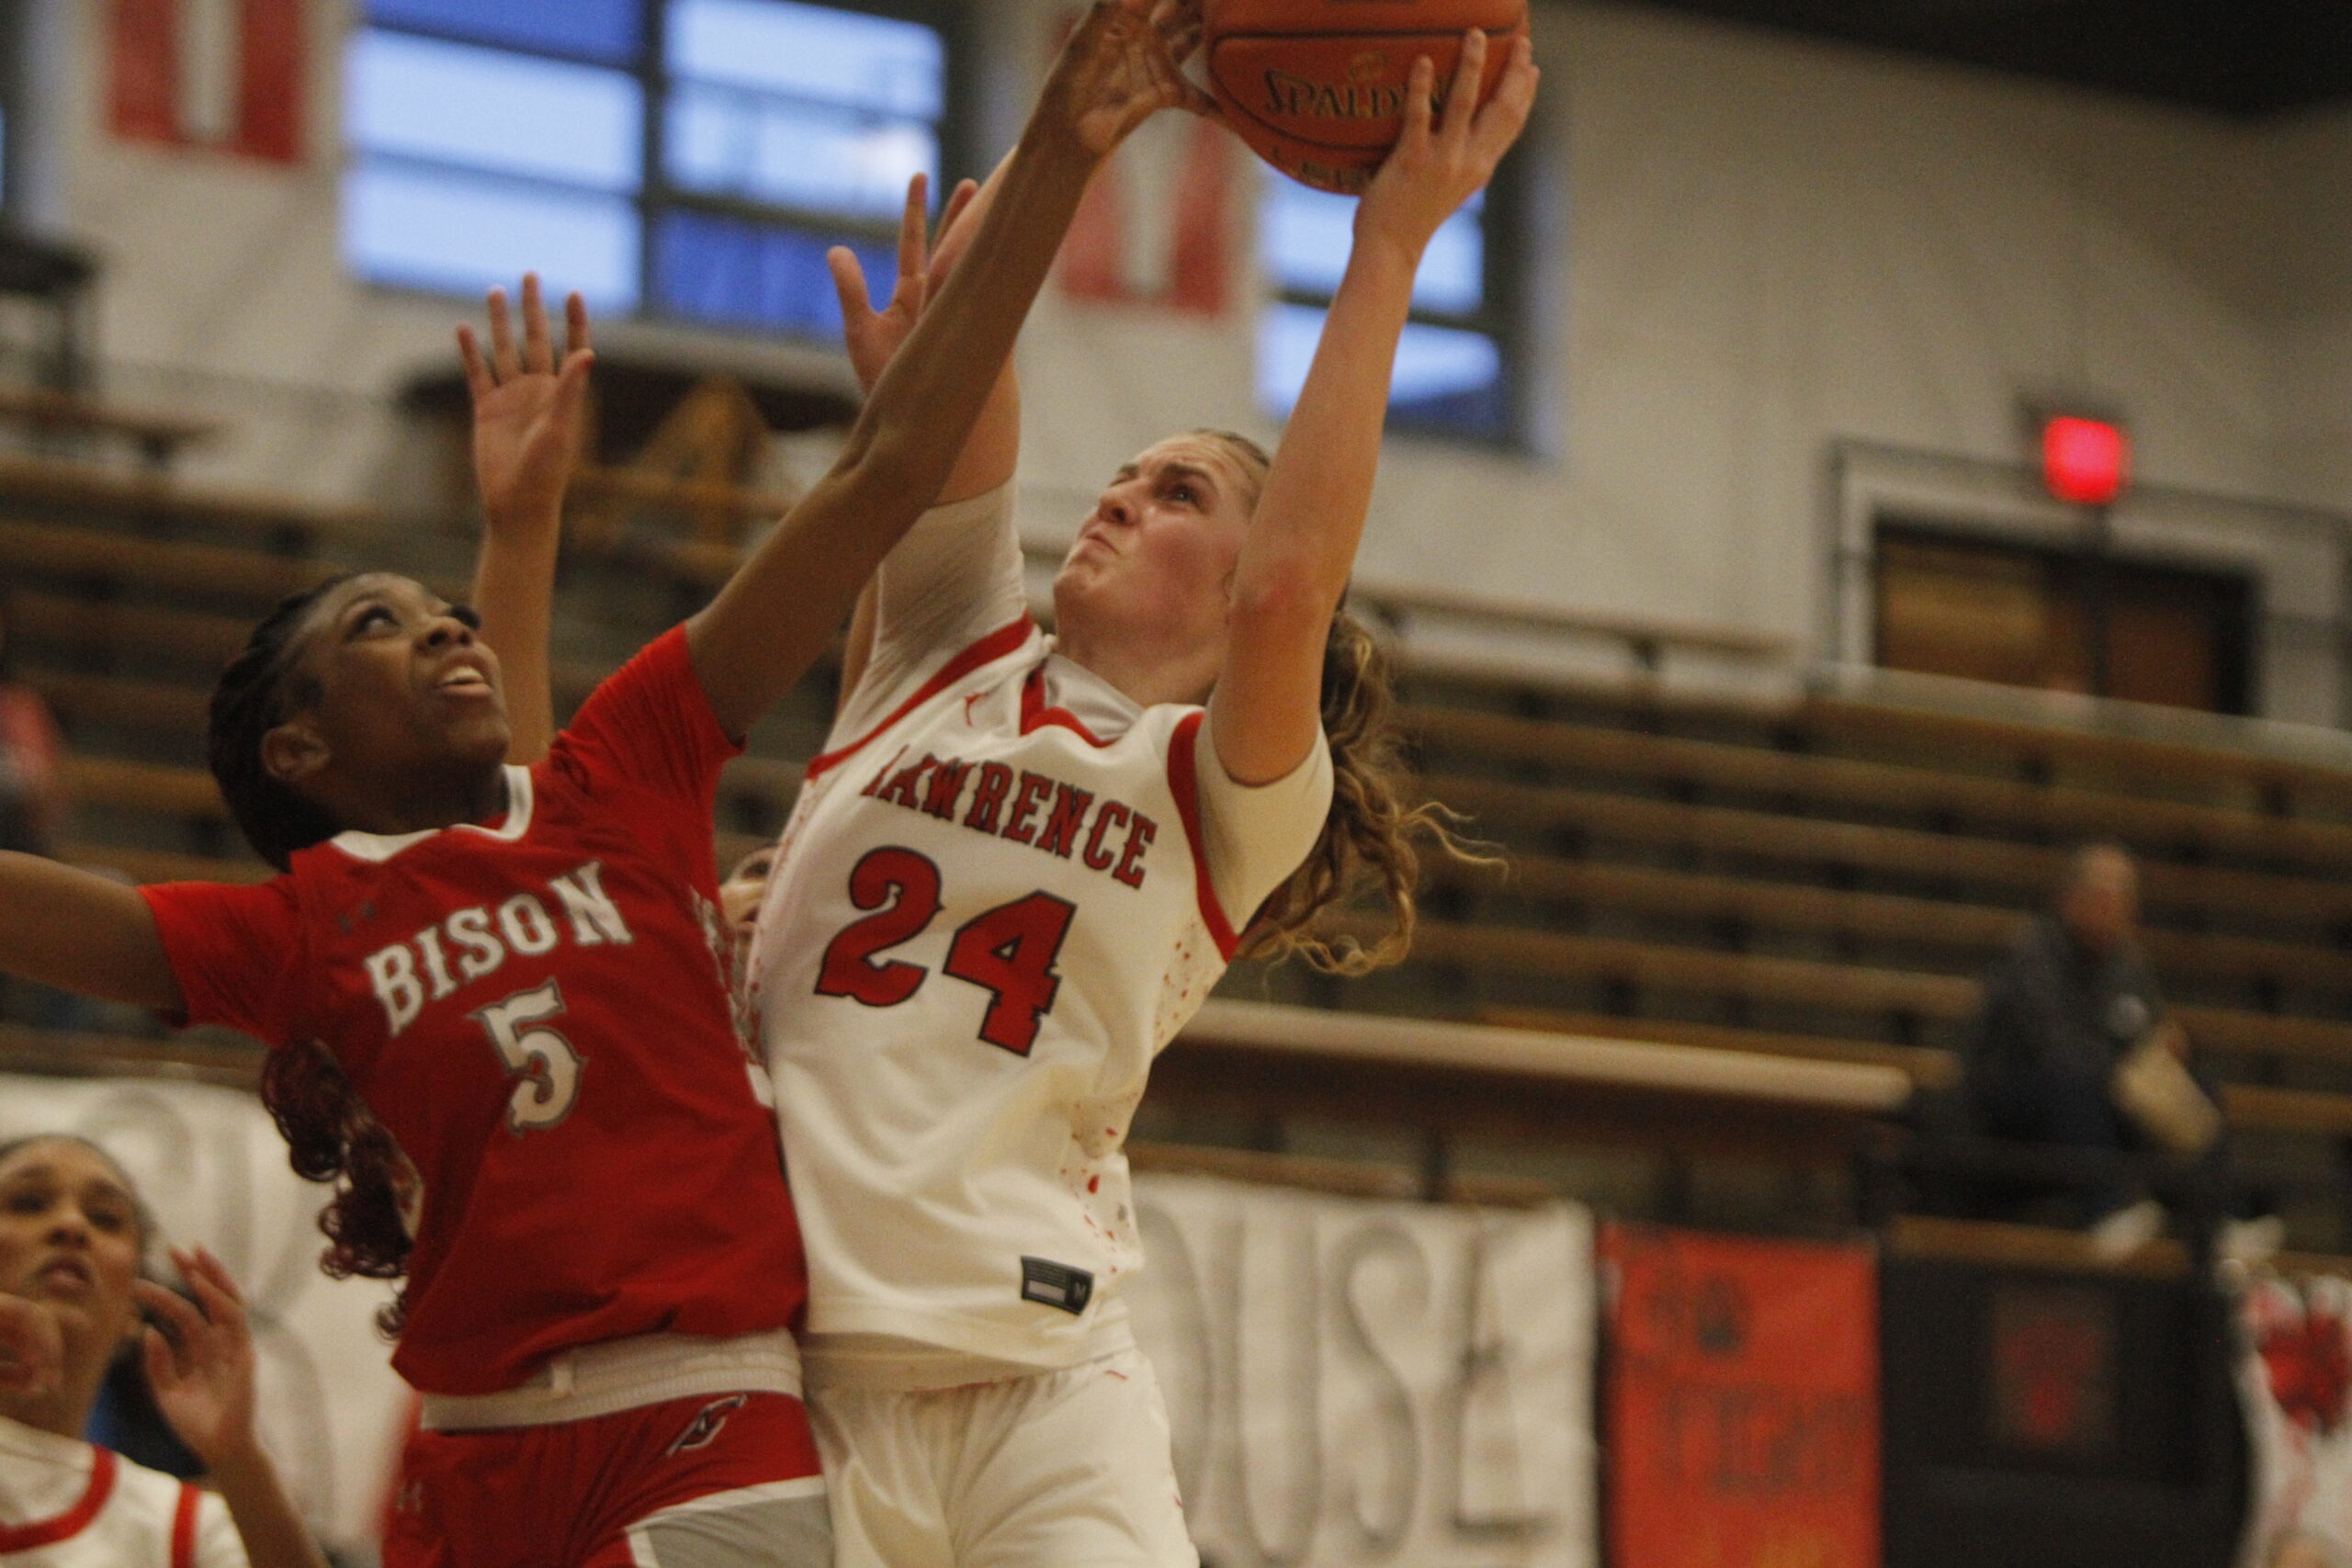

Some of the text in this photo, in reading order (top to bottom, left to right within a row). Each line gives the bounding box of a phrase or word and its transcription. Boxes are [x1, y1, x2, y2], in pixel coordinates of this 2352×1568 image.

[1262, 66, 1448, 118] SPALD
[365, 860, 635, 1038] BISON
[812, 844, 1078, 1058] 24
[464, 977, 589, 1138] 5
